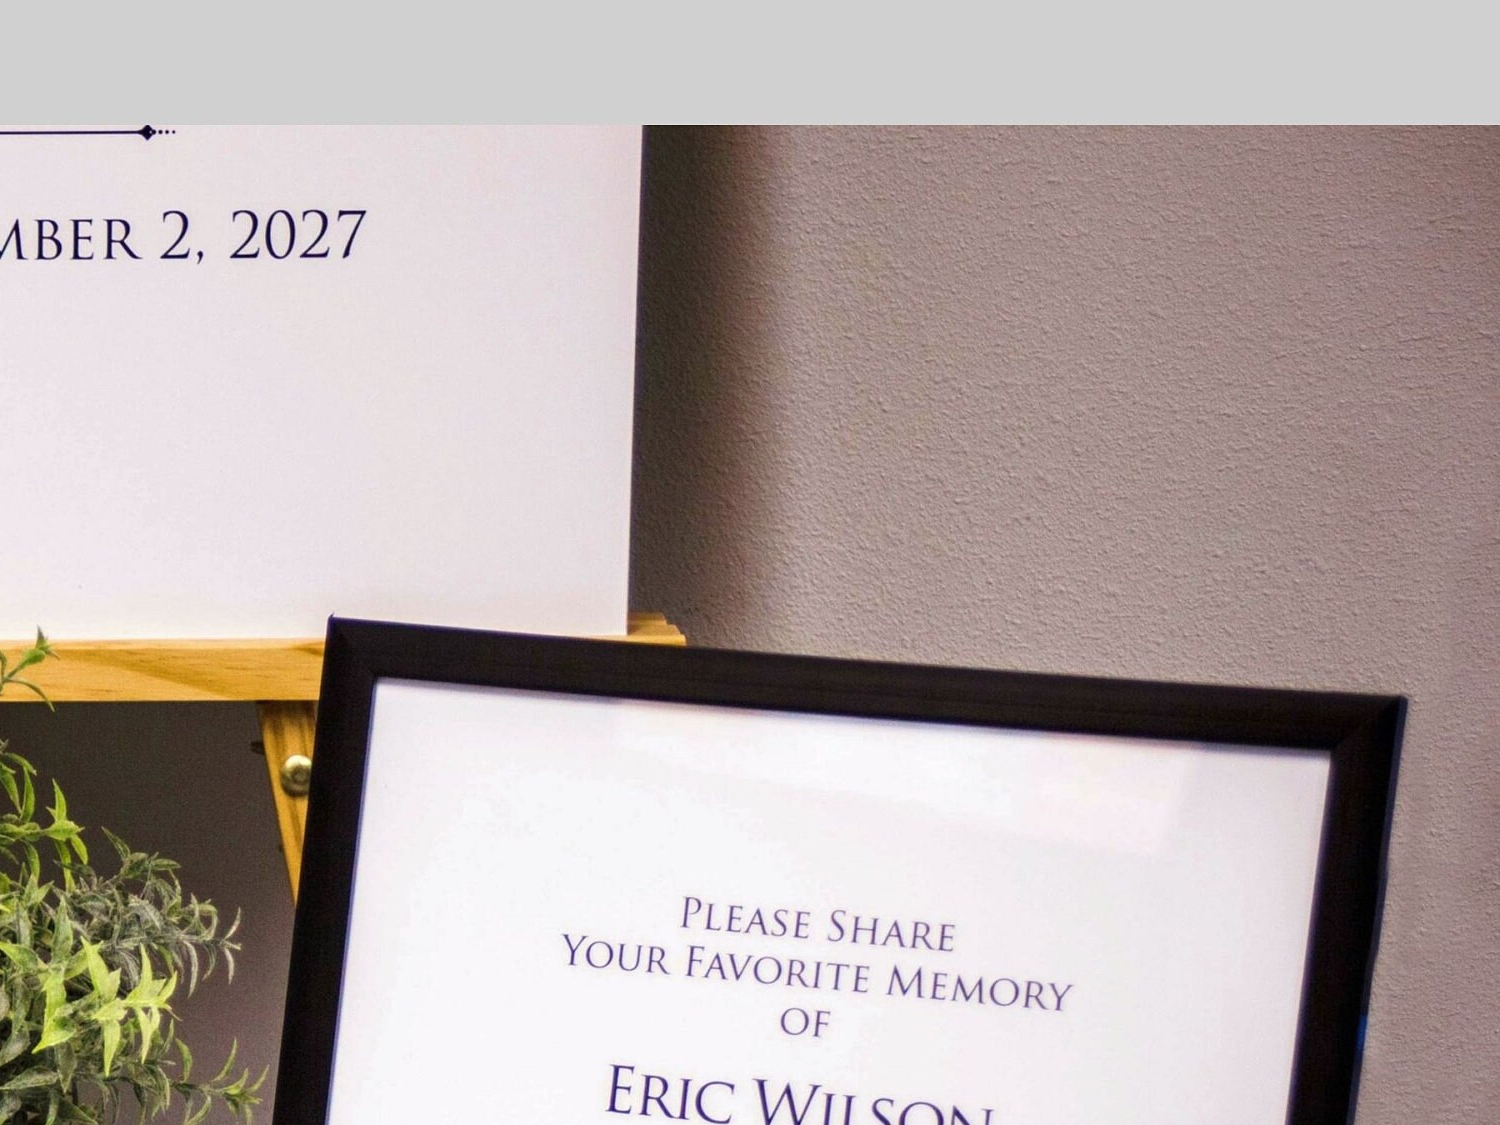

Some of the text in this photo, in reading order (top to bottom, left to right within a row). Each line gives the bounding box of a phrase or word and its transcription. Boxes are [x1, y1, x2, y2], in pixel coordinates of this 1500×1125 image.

[158, 211, 206, 266] 2,
[229, 209, 368, 264] 2027
[679, 896, 957, 953] PLEASE SHARE
[560, 933, 1075, 1013] YOUR FAVORITE MEMORY
[779, 1008, 832, 1039] OF
[604, 1063, 737, 1125] ERIC
